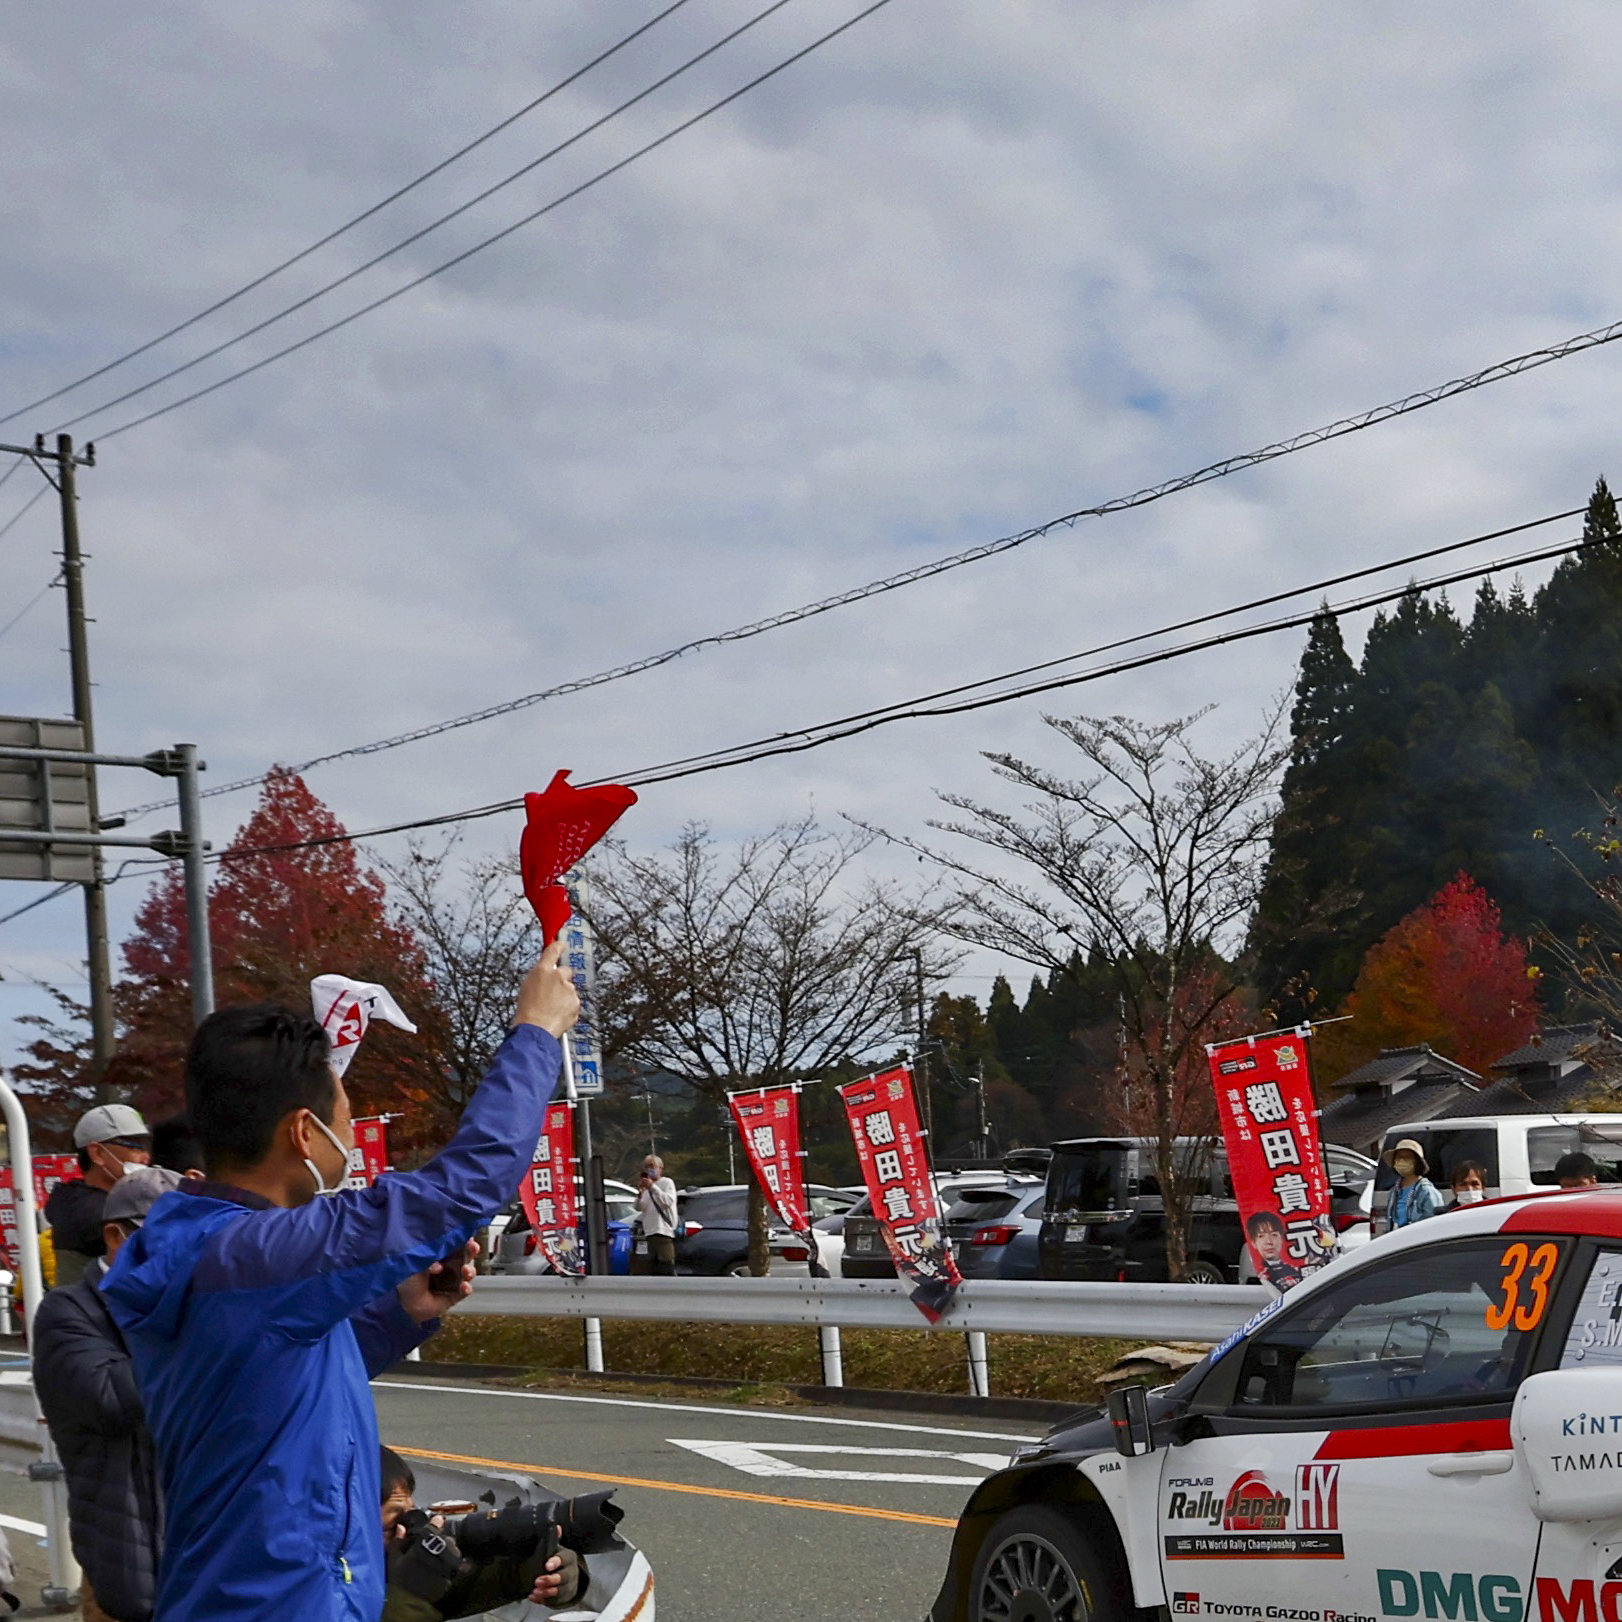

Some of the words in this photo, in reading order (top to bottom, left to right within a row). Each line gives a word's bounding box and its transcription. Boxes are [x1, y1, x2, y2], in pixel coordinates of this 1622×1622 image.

[1486, 1243, 1558, 1331] 33
[1098, 1461, 1122, 1474] PIAA
[1168, 1477, 1214, 1488] FORUM8
[1296, 1465, 1340, 1529] HY
[1168, 1491, 1224, 1526] Rally
[1226, 1490, 1291, 1524] Japan
[1260, 1517, 1281, 1528] 2022
[1195, 1540, 1207, 1549] FIA
[1208, 1540, 1228, 1550] World
[1229, 1540, 1246, 1551] Rally
[1247, 1540, 1296, 1551] Championship
[1173, 1600, 1199, 1614] GR
[1204, 1601, 1262, 1616] TOYOTA
[1266, 1606, 1320, 1622] GAZOO
